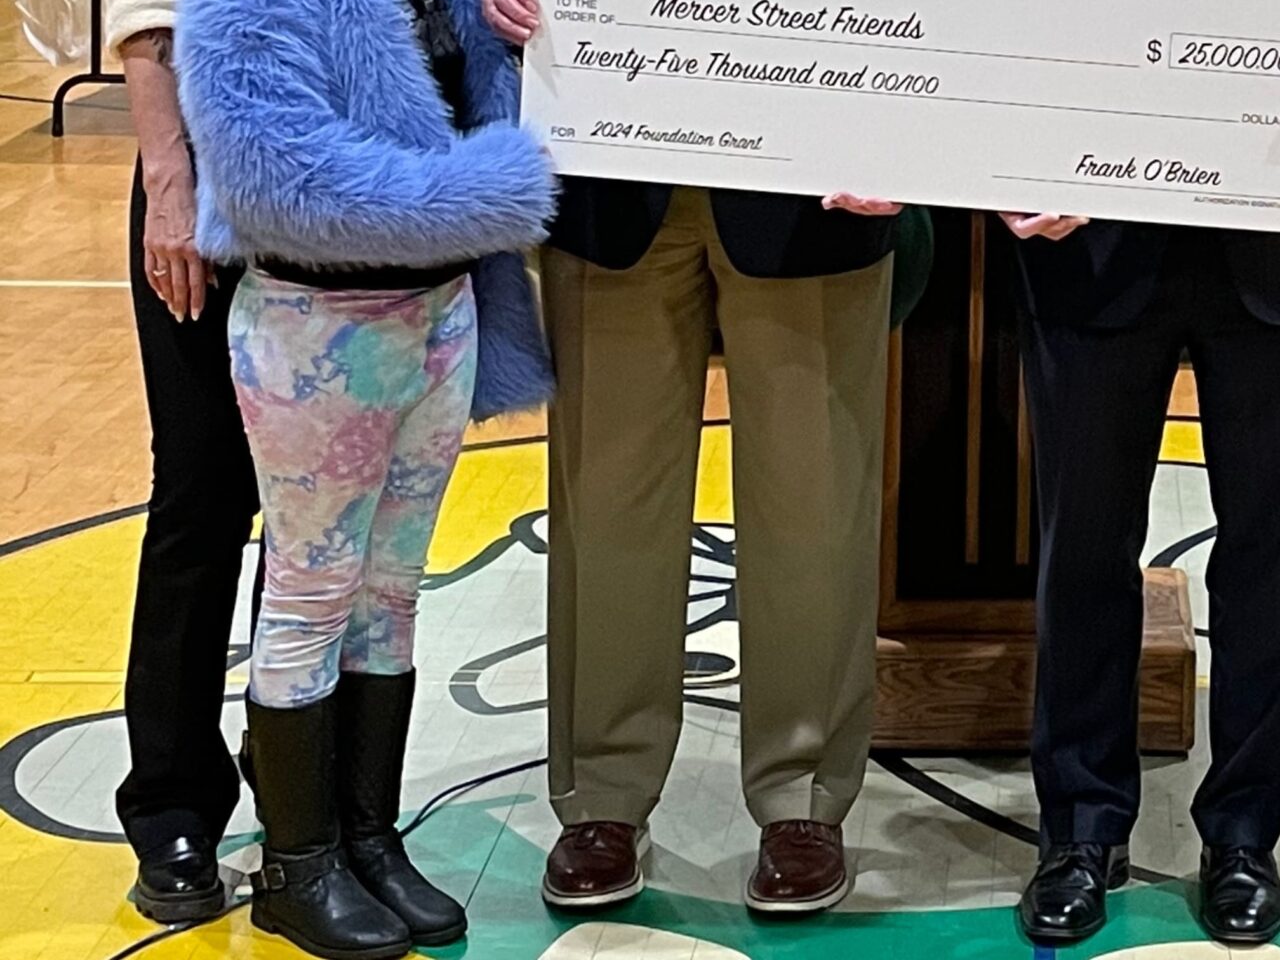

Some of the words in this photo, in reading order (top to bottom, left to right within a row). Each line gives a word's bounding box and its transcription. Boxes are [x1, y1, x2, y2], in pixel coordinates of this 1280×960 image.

[554, 10, 596, 22] ORDER
[599, 13, 615, 24] OF
[746, 0, 827, 34] Street
[830, 7, 925, 40] Friends
[1146, 39, 1162, 64] $
[571, 41, 699, 81] Twenty-Five
[705, 52, 815, 86] Thousand
[818, 64, 865, 90] and
[871, 71, 941, 95] 00/100
[550, 126, 575, 138] FOR
[590, 120, 634, 138] 2024
[634, 125, 716, 146] Foundation
[718, 132, 764, 150] Grant
[1075, 154, 1138, 180] Frank
[1143, 158, 1222, 186] O'Brien
